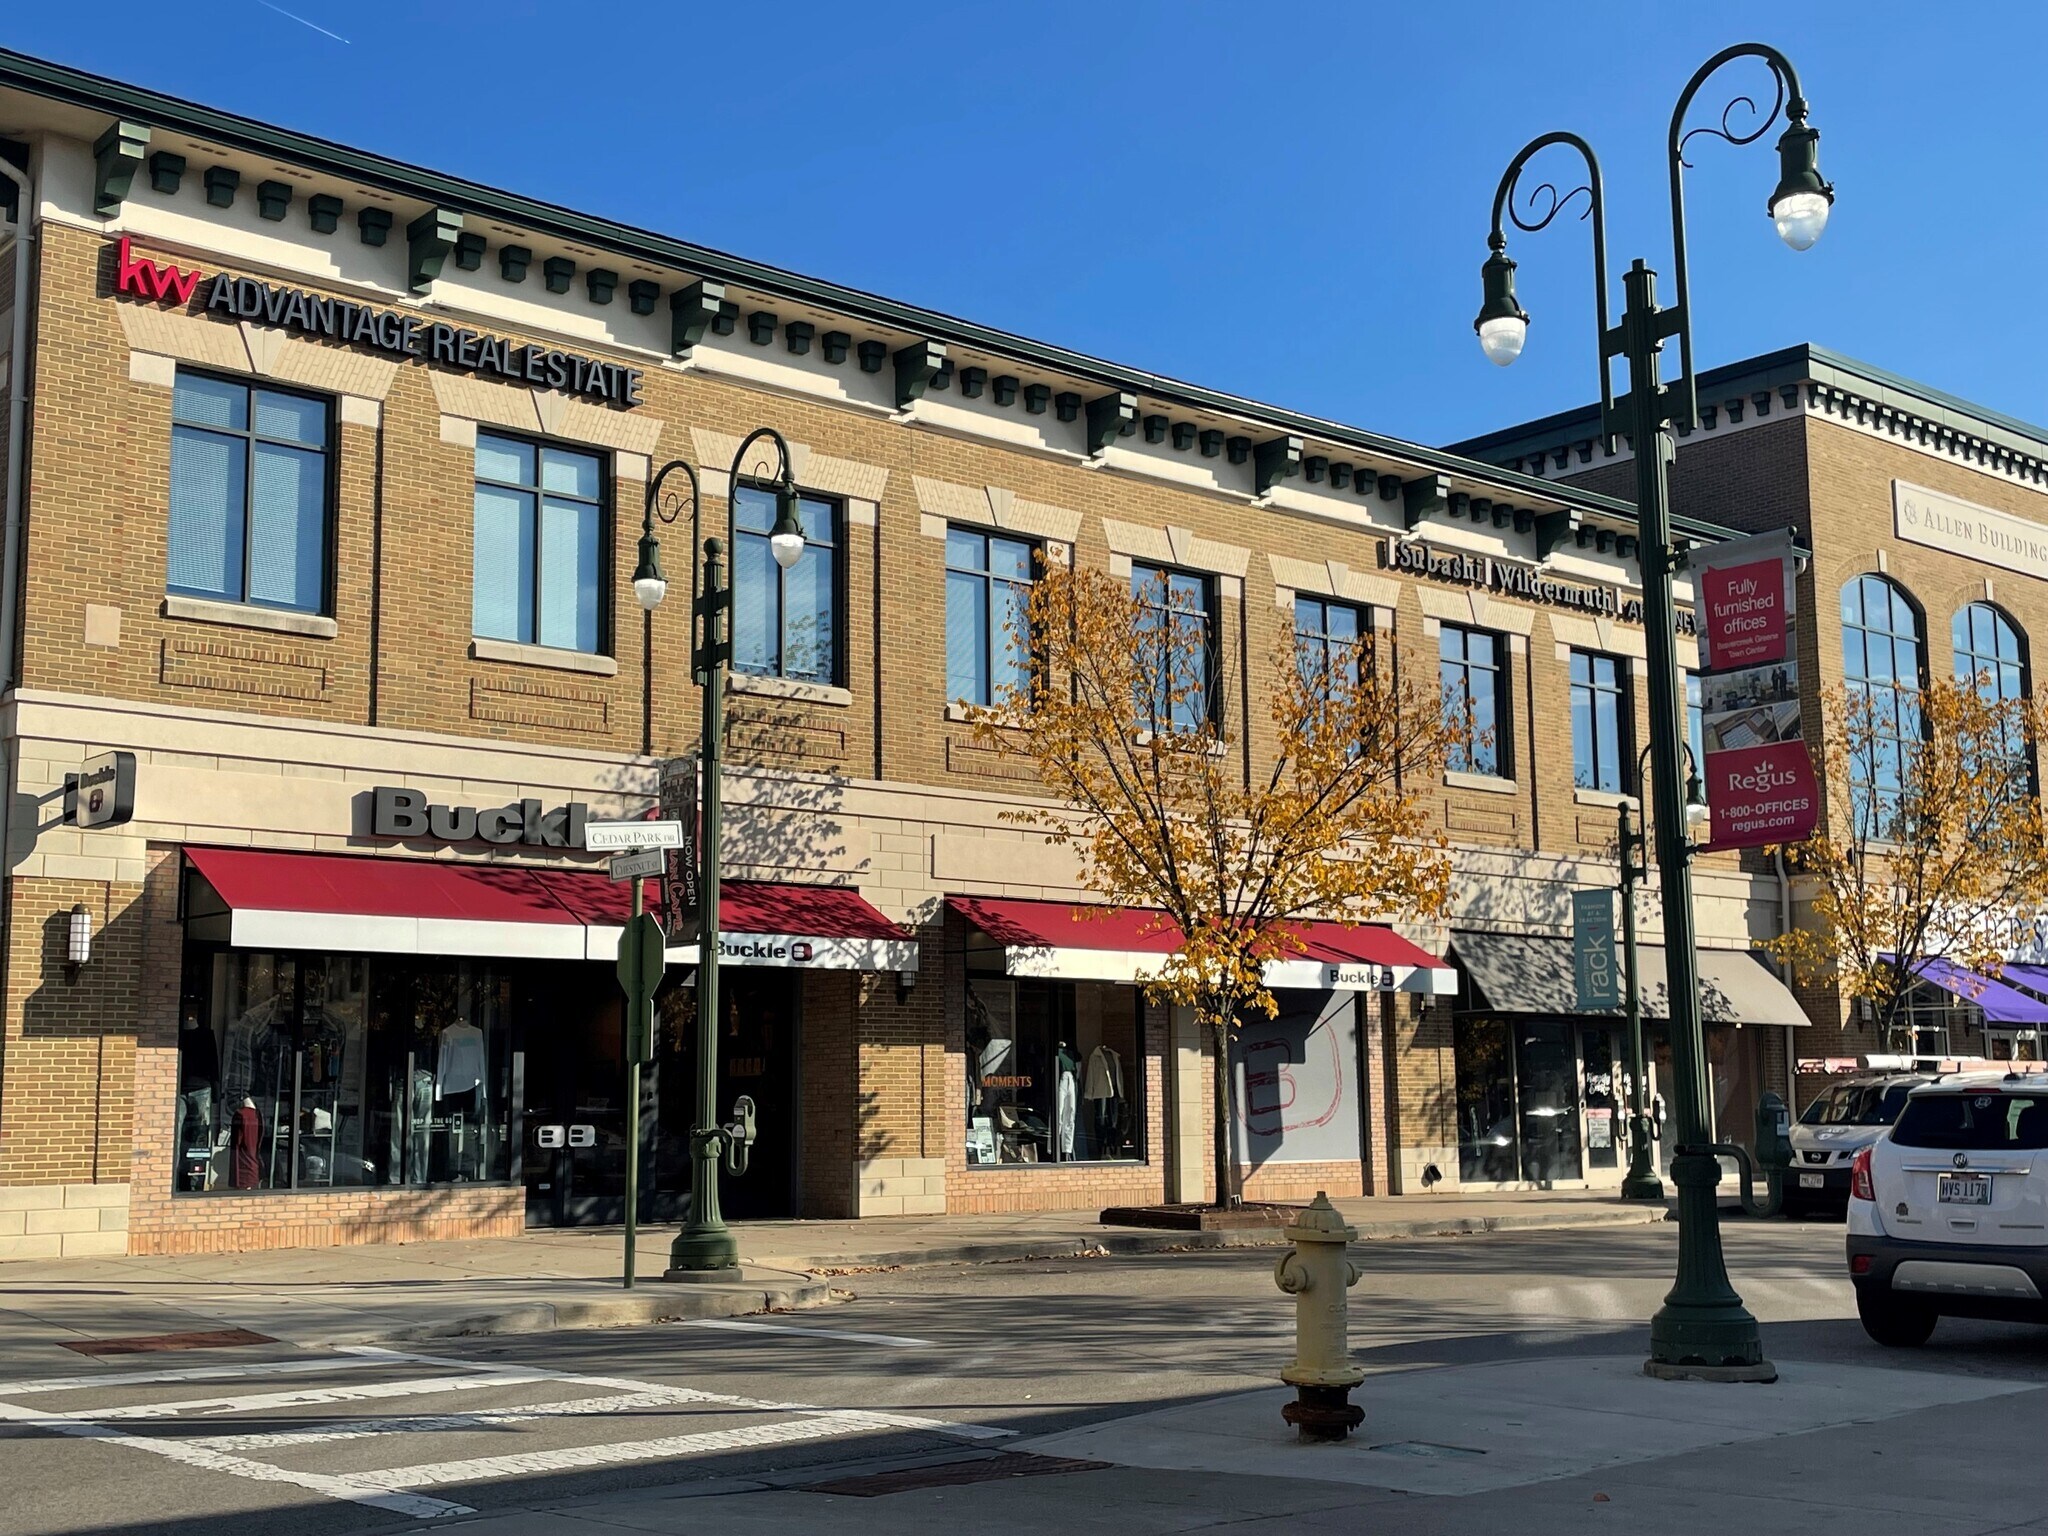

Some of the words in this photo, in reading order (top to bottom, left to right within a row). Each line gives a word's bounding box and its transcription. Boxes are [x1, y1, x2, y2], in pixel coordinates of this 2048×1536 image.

[117, 237, 201, 304] kw
[208, 273, 423, 357] ADVANTAGE
[1924, 507, 1973, 541] ALLEN
[1978, 522, 2048, 562] BUILDING
[1400, 541, 1483, 583] Subashi
[1495, 562, 1615, 612] Wildermuth
[1727, 578, 1758, 597] Fully
[1713, 591, 1775, 618] furnished
[1723, 615, 1767, 635] offices
[1728, 769, 1797, 793] Regus
[374, 786, 588, 848] Buckl
[1719, 798, 1809, 819] 1-800-OFFICES
[1731, 815, 1795, 833] regus.com
[592, 832, 632, 845] CEDAR
[632, 831, 662, 843] PARK
[684, 835, 693, 868] NOW
[614, 860, 651, 876] CHESTNUT
[685, 870, 697, 906] OPEN
[717, 941, 787, 959] Buckle
[1329, 969, 1379, 985] Buckle
[1583, 934, 1610, 998] rack
[982, 1075, 1032, 1088] MOMENTS
